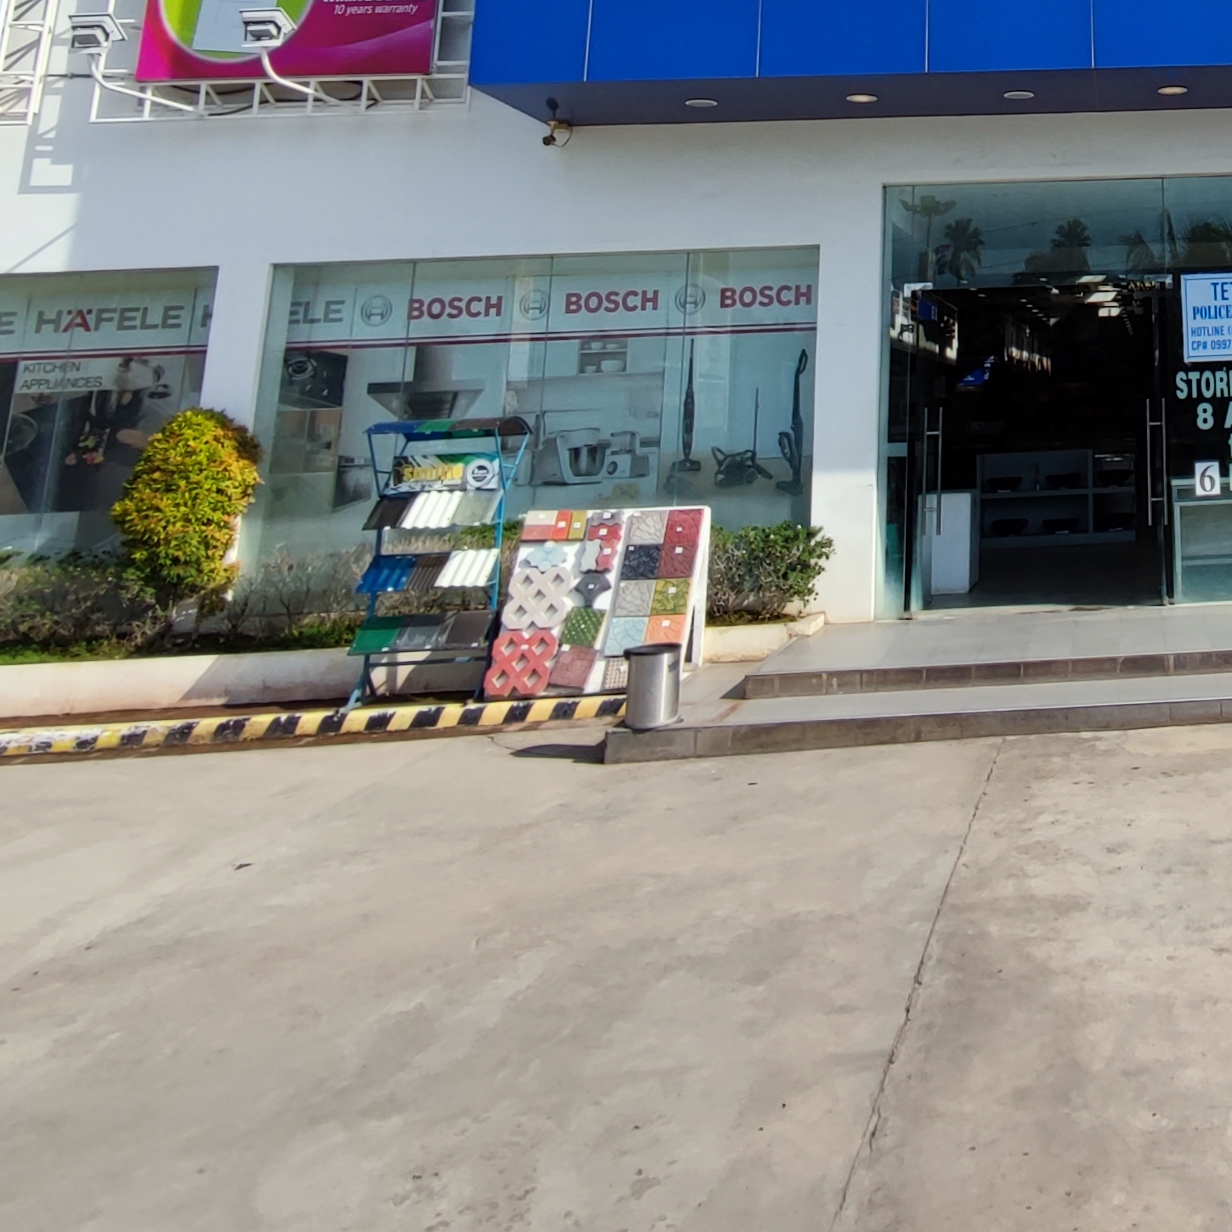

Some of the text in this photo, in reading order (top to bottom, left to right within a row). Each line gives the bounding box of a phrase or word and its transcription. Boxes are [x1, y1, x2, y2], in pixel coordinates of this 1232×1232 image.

[333, 3, 418, 16] 10 years warranty
[565, 289, 660, 314] BOSCH
[720, 284, 812, 309] BOSCH
[407, 295, 503, 321] BOSCH
[1192, 304, 1232, 320] POLICE
[34, 305, 185, 334] HÄFELE
[1191, 325, 1225, 337] HOTLINE
[1191, 340, 1208, 351] CP#
[1210, 339, 1232, 350] 0997
[22, 361, 81, 375] KITCHEN
[20, 376, 103, 390] APPLIANCES
[1196, 402, 1214, 430] 8
[1199, 464, 1216, 492] 6
